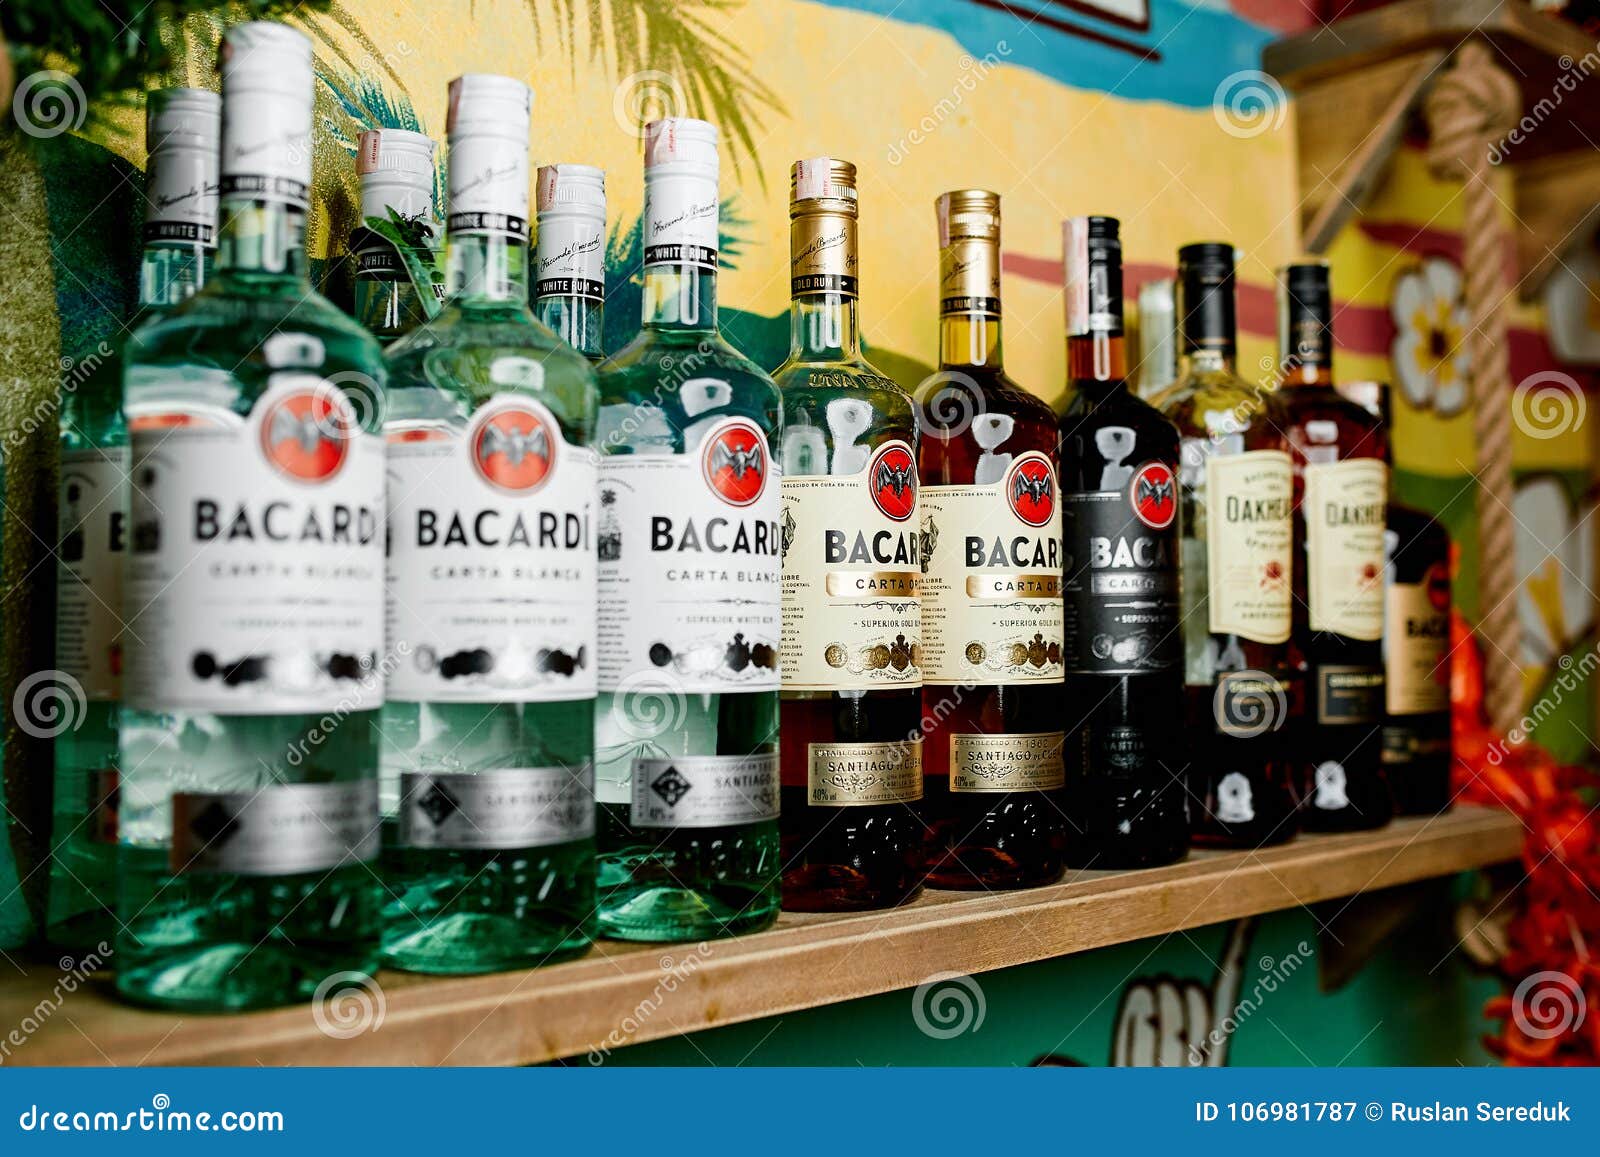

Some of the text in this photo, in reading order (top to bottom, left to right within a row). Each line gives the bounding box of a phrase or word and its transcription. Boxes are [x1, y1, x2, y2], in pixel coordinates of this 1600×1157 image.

[656, 246, 687, 259] WHITE
[364, 255, 393, 266] WHITE
[542, 280, 590, 292] WHITE RUM
[814, 278, 832, 288] RUM
[194, 499, 376, 546] BACARD
[651, 516, 780, 557] BACARD
[666, 570, 728, 582] CARTA
[856, 578, 904, 590] CARTA
[994, 582, 1042, 592] CARTA
[861, 620, 900, 628] SUPERIOR
[968, 751, 1032, 760] SANTIAGO
[828, 760, 894, 772] SANTIAGO
